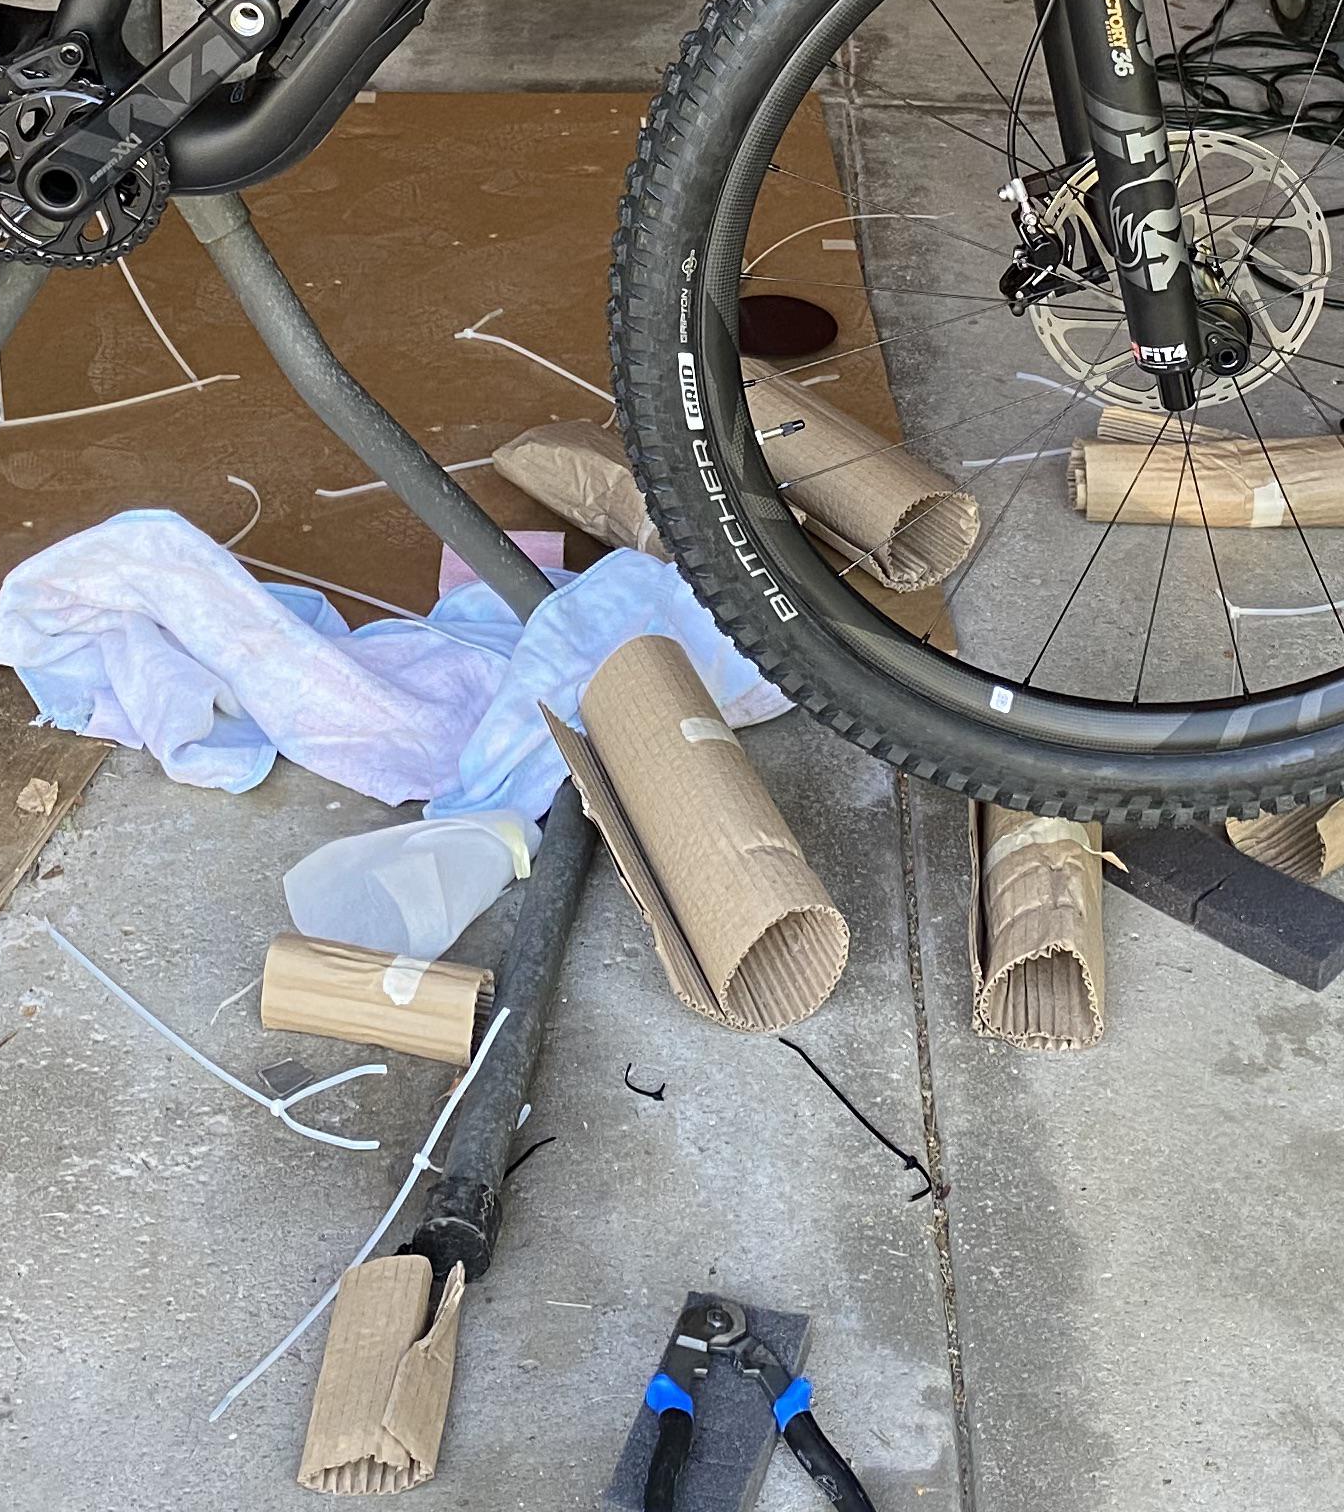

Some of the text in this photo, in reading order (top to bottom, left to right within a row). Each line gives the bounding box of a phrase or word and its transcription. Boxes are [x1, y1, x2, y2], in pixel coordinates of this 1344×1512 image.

[1111, 48, 1134, 77] 36
[680, 288, 798, 622] BUTCHER GRID GRIPTON
